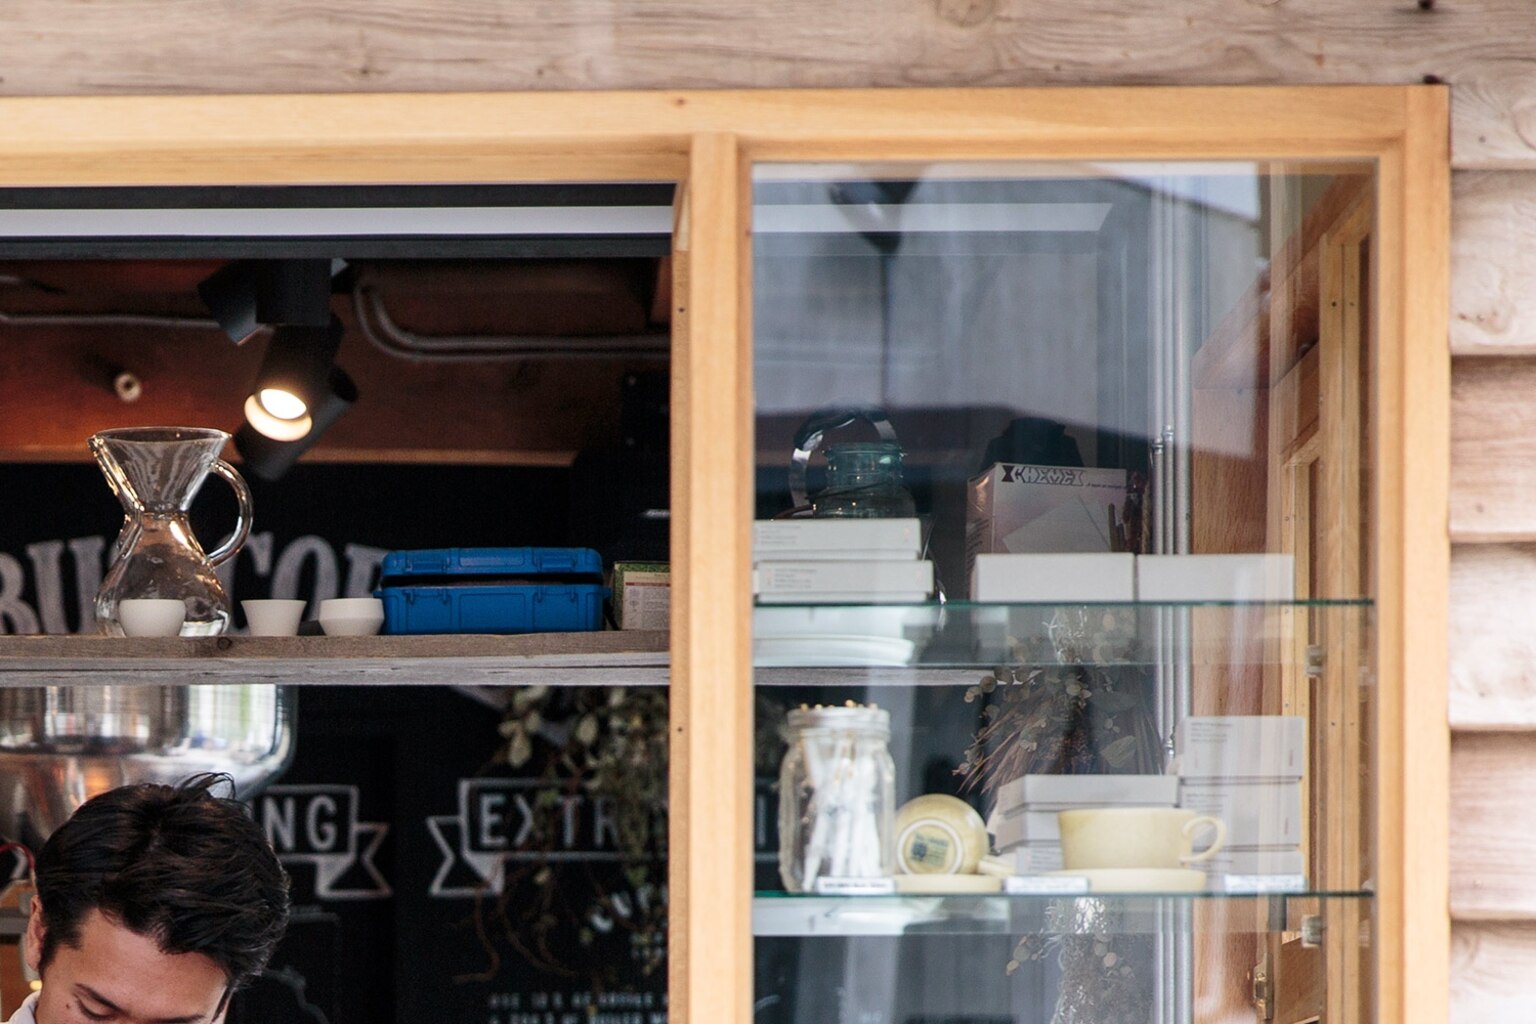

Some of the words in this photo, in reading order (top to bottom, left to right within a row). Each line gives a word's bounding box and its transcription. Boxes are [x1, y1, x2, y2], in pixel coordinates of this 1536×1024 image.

[1013, 465, 1086, 486] CHEMEX
[248, 795, 338, 851] NG
[480, 795, 660, 847] EXTR
